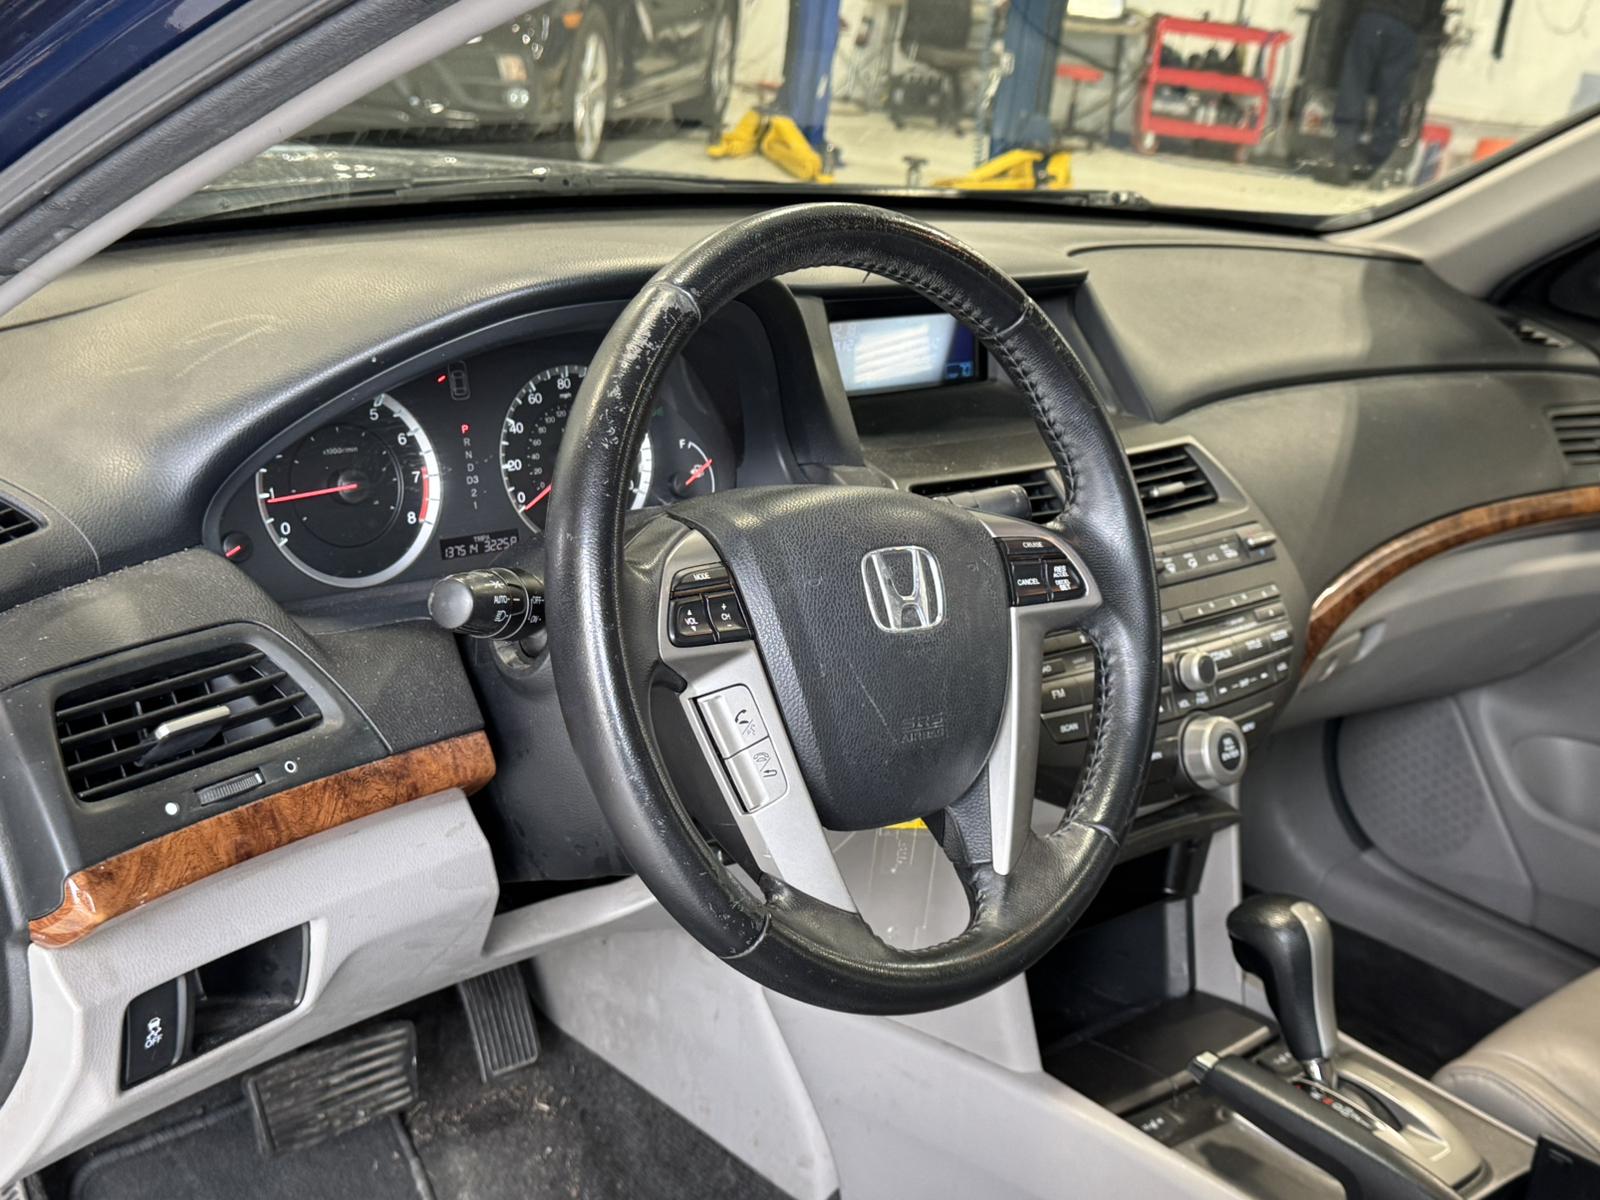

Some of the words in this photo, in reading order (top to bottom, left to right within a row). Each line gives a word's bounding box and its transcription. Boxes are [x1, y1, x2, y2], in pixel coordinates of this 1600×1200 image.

[557, 378, 571, 389] 80
[528, 392, 542, 404] 60
[369, 408, 379, 421] 5
[545, 416, 556, 424] 100
[461, 424, 469, 434] P
[509, 422, 524, 434] 40
[397, 432, 407, 445] 6
[463, 437, 471, 447] R
[679, 438, 686, 449] F
[465, 450, 473, 459] N
[467, 463, 475, 472] D
[507, 459, 522, 471] 20
[411, 471, 420, 483] 7
[466, 475, 479, 485] D3
[471, 488, 478, 498] 2
[517, 492, 526, 503] 0
[407, 511, 417, 524] 8
[280, 522, 291, 535] 0
[1022, 541, 1044, 549] CRUISE
[693, 572, 711, 580] MODE
[1017, 578, 1040, 586] CANCEL
[494, 596, 508, 604] AUTO
[684, 617, 699, 626] VOL
[721, 612, 732, 621] CH
[1051, 688, 1066, 700] FM
[1060, 722, 1079, 733] SCAN
[145, 1033, 163, 1049] OFF
